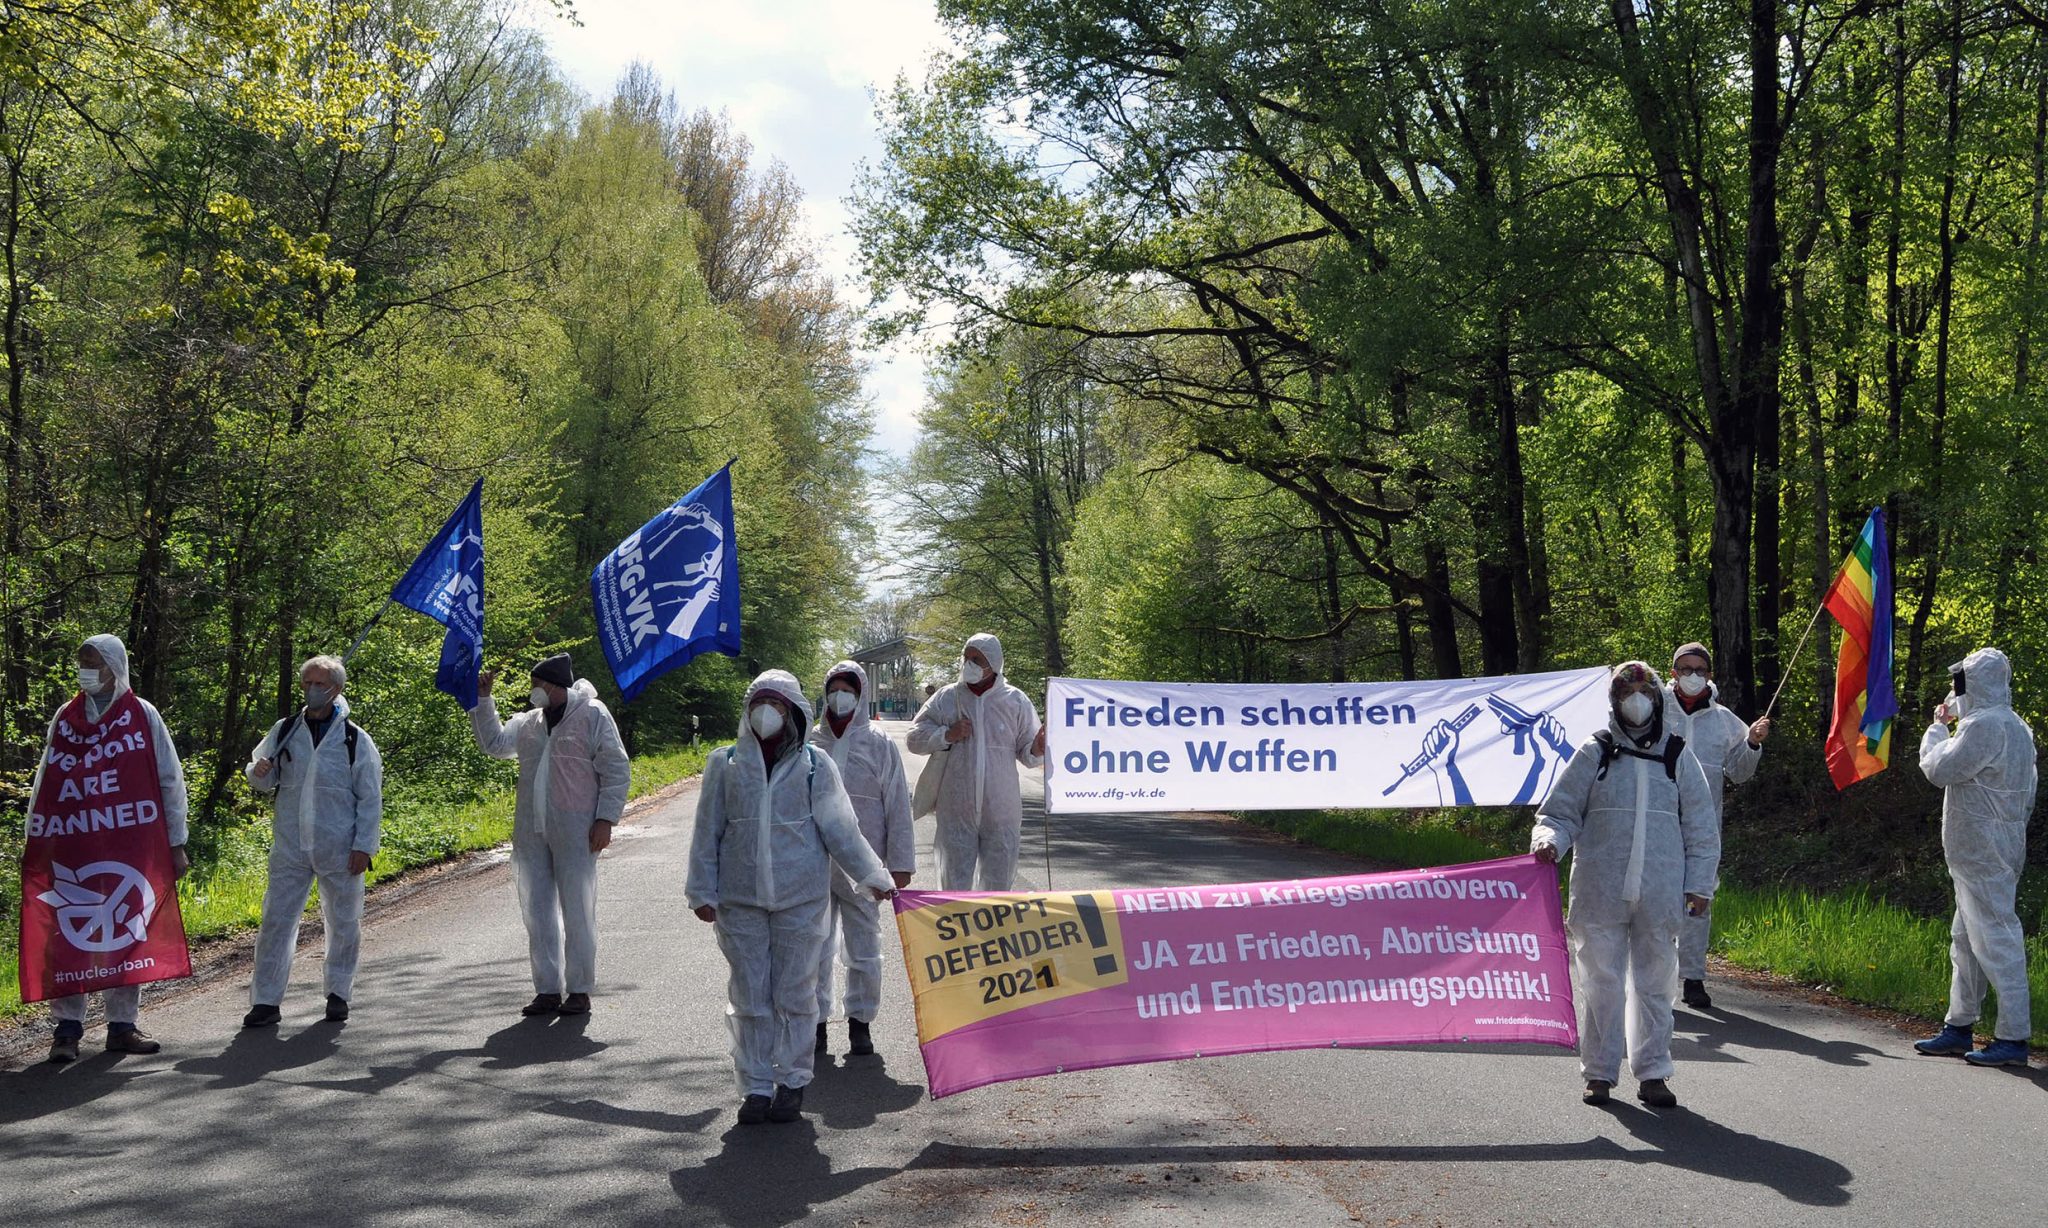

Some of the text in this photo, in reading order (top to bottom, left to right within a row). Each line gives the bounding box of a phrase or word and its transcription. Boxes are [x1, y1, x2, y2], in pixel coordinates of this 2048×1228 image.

[618, 531, 660, 649] DFG-VK
[1064, 696, 1417, 727] Frieden schaffen
[1063, 739, 1338, 774] ohne Waffen
[58, 769, 120, 801] ARE
[1064, 788, 1167, 801] www.dfg-vk.de
[29, 801, 158, 838] BANNED
[1122, 874, 1528, 915] NEIN zu Kriegsmanövern.
[935, 898, 1048, 941] STOPPT
[924, 920, 1083, 984] DEFENDER
[1134, 926, 1541, 971] JA zu Frieden, Abrüstung
[55, 956, 155, 984] #nuclearban
[978, 963, 1054, 1005] 2021
[1136, 971, 1552, 1019] und Entspannungspolitik!
